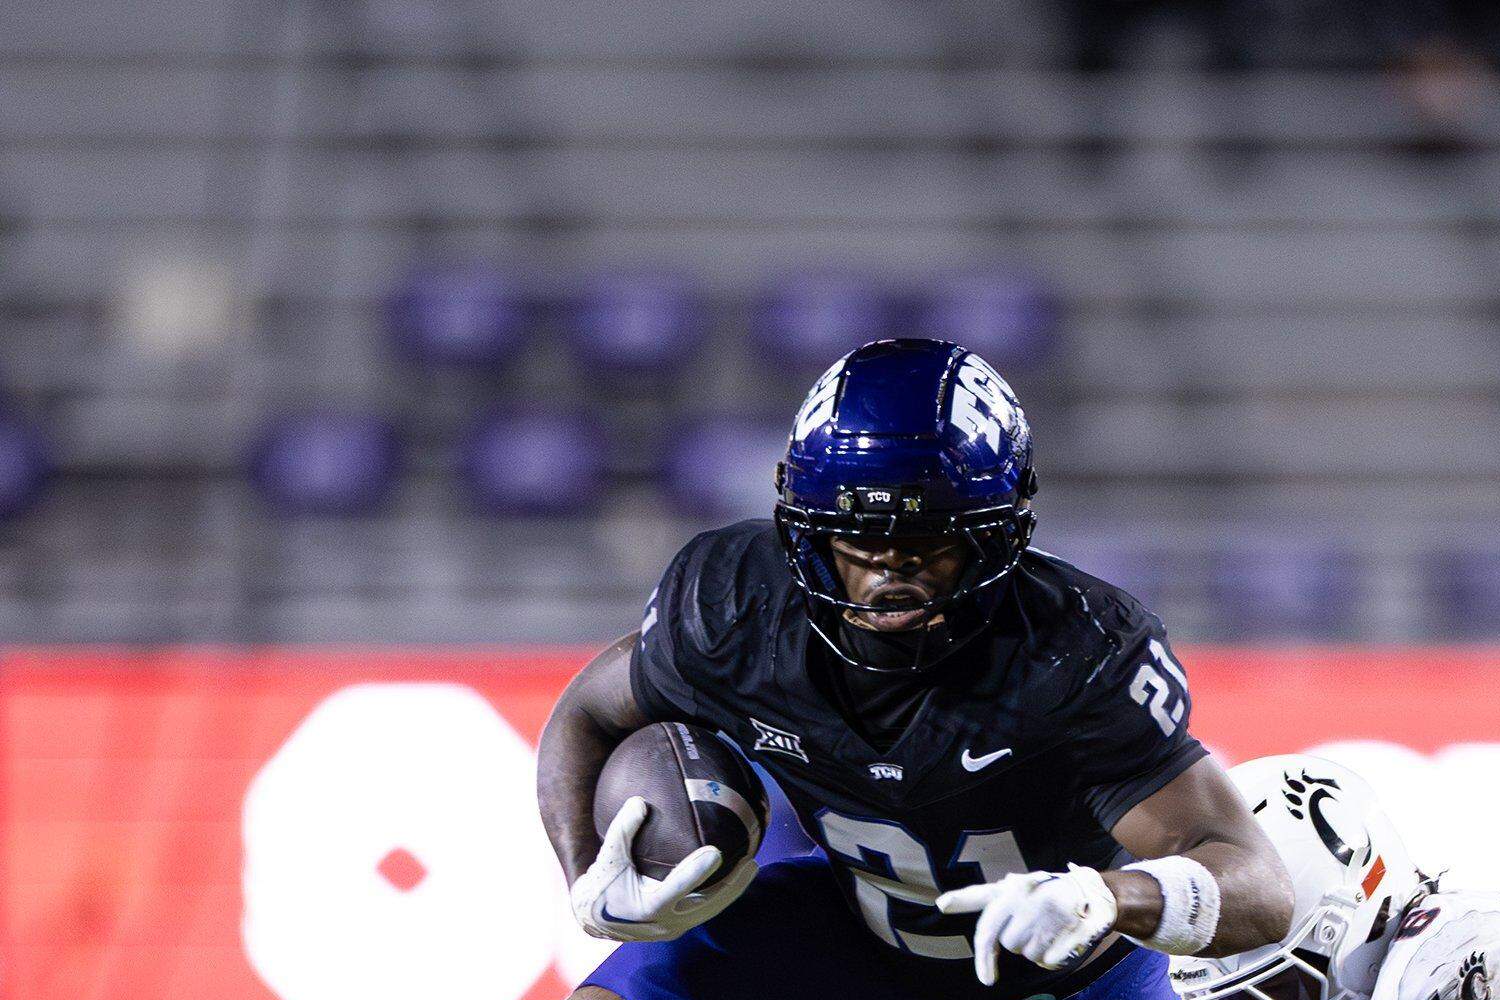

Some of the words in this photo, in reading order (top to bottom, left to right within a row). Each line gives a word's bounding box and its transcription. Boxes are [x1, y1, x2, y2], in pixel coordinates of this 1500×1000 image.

[867, 491, 891, 503] TCU
[1129, 638, 1188, 737] 21
[868, 763, 904, 781] TCU
